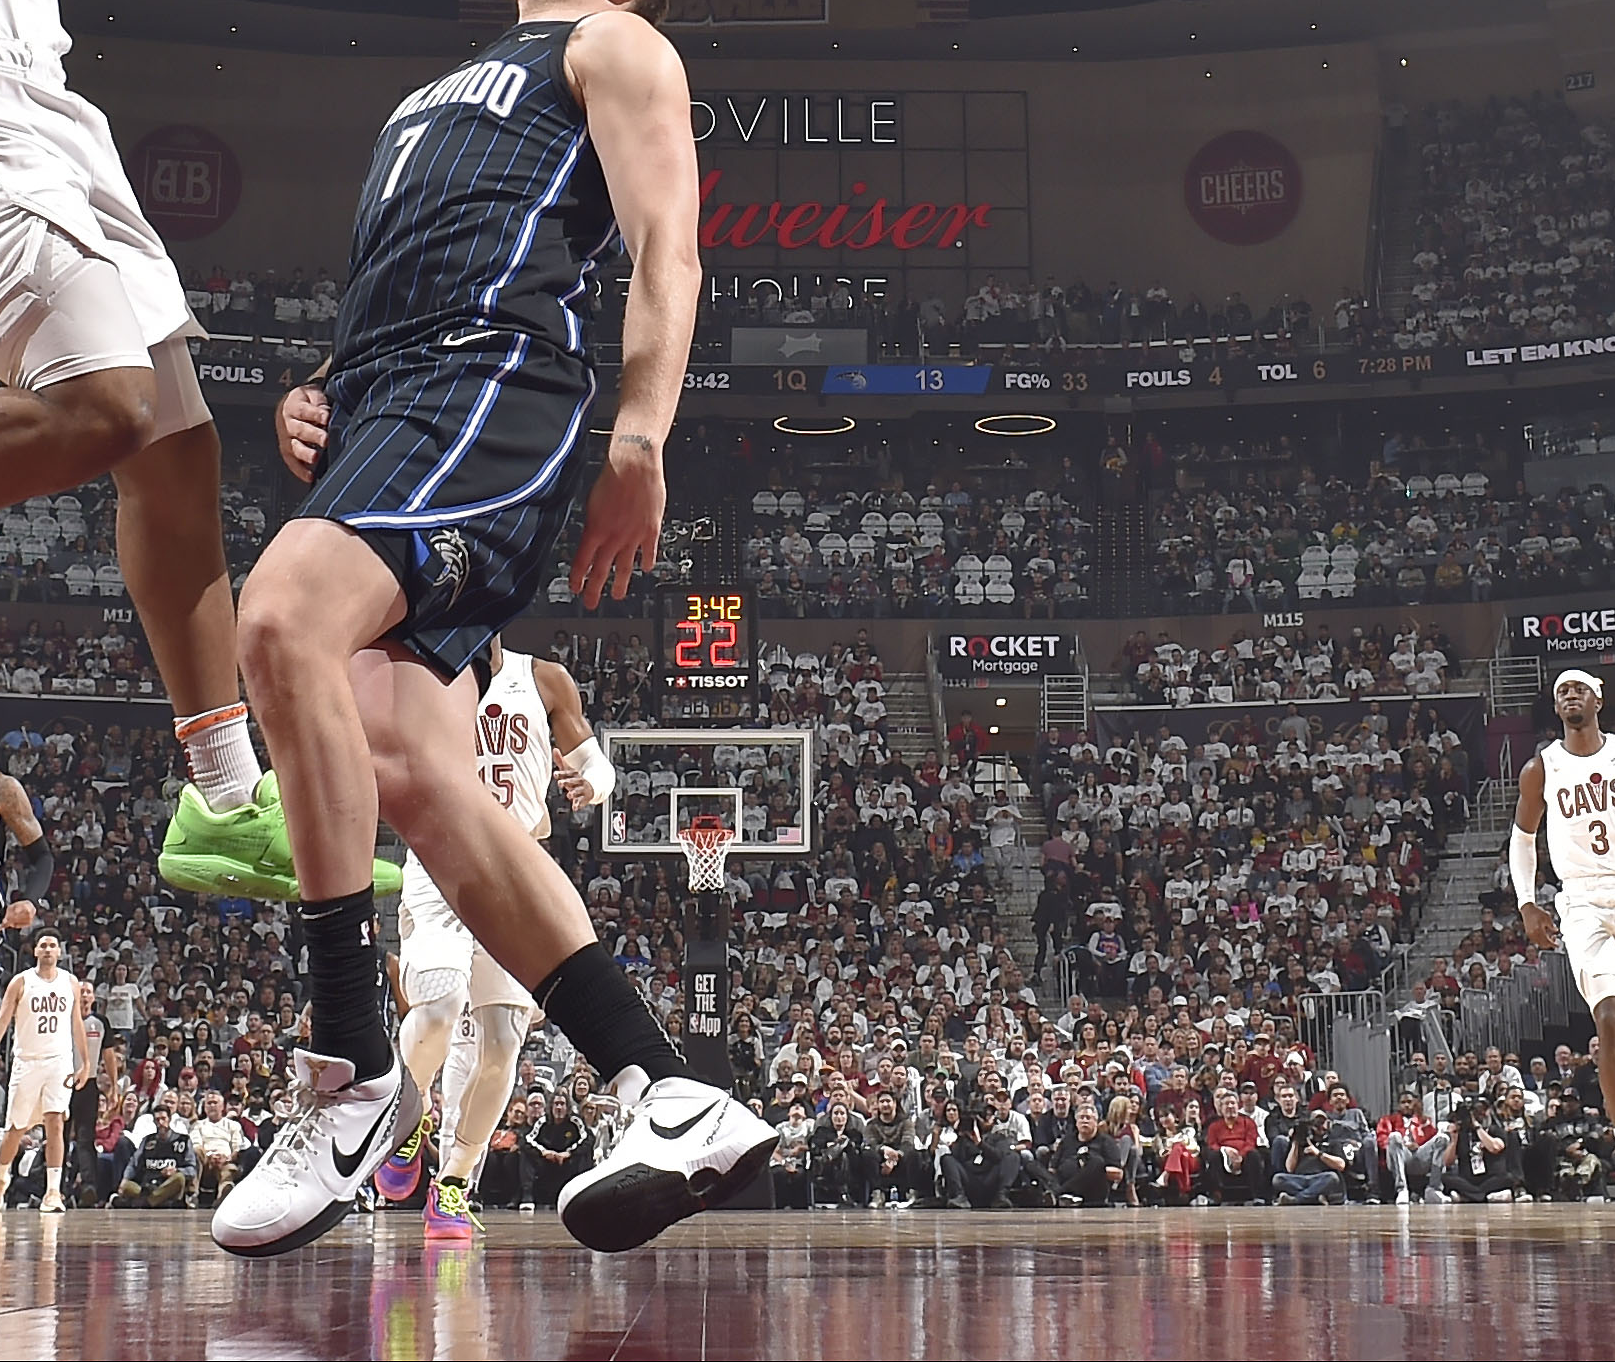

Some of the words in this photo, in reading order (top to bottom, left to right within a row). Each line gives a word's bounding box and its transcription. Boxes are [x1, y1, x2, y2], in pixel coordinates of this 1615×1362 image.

[1567, 74, 1592, 89] 217
[381, 121, 431, 203] 7
[1200, 169, 1285, 207] CHEERS
[698, 169, 991, 250] weiser
[1358, 357, 1396, 374] 7:28
[1402, 355, 1431, 372] PM
[1466, 347, 1516, 366] LET
[1521, 344, 1560, 362] EM
[199, 364, 264, 383] FOULS
[279, 368, 293, 386] 4
[684, 373, 730, 389] 3:42
[773, 370, 806, 391] 1Q
[915, 369, 943, 390] 13
[1127, 369, 1191, 388] FOULS
[1208, 367, 1222, 385] 4
[1258, 364, 1297, 380] TOL
[1312, 361, 1326, 379] 6
[1005, 373, 1050, 390] FG%
[1062, 373, 1087, 391] 33
[687, 596, 741, 620] 3:42
[1263, 613, 1303, 628] M115
[676, 621, 736, 668] 22
[950, 636, 1060, 657] ROCKET
[1546, 637, 1613, 651] Mortgage
[972, 659, 1038, 674] Mortgage
[688, 676, 748, 688] TISSOT
[1588, 820, 1610, 855] 3
[695, 974, 716, 993] GET
[31, 995, 66, 1013] CAVS
[695, 994, 716, 1012] THE
[37, 1016, 57, 1034] 20
[700, 1013, 721, 1037] App
